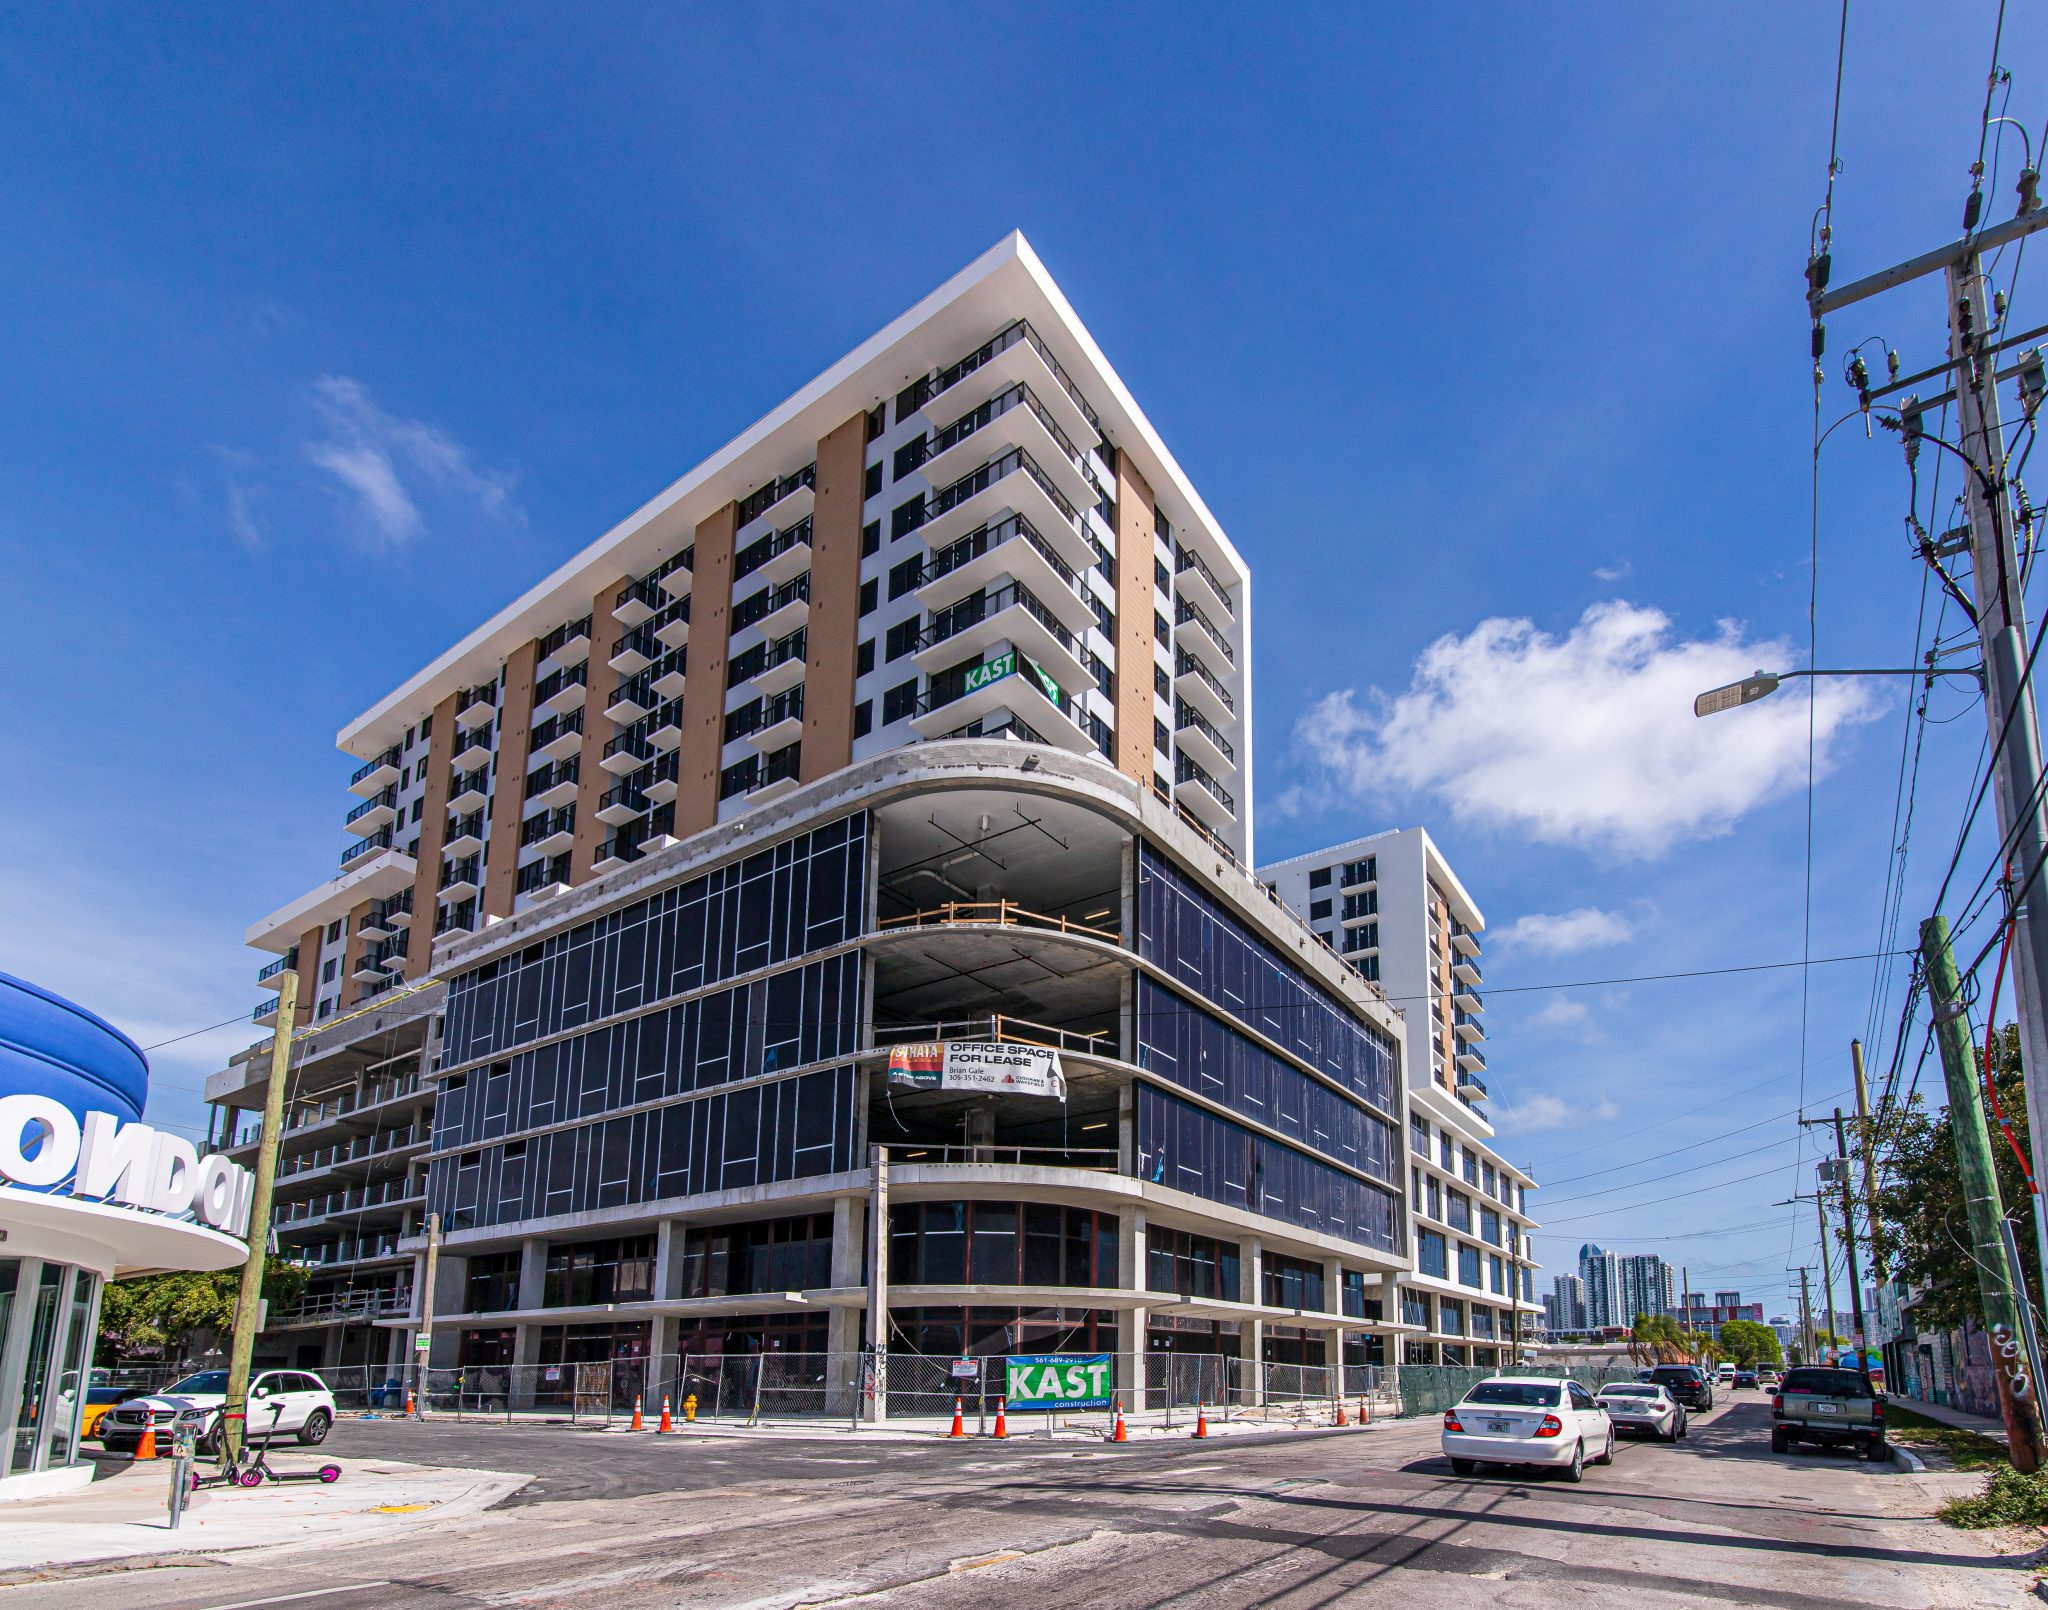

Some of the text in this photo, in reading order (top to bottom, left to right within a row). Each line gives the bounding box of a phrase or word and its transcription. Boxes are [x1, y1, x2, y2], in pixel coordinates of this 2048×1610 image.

[965, 653, 1013, 690] KAST
[896, 1045, 938, 1058] STRATA
[950, 1043, 1054, 1059] OFFICE SPACE
[949, 1054, 1031, 1066] FOR LEASE
[949, 1065, 985, 1075] Brian Gale
[948, 1074, 996, 1083] 305-351-2462
[1015, 1075, 1040, 1083] CUSHMAN
[1015, 1079, 1045, 1087] WAKEFIELD
[1009, 1365, 1107, 1399] KAST
[1054, 1399, 1107, 1408] construction
